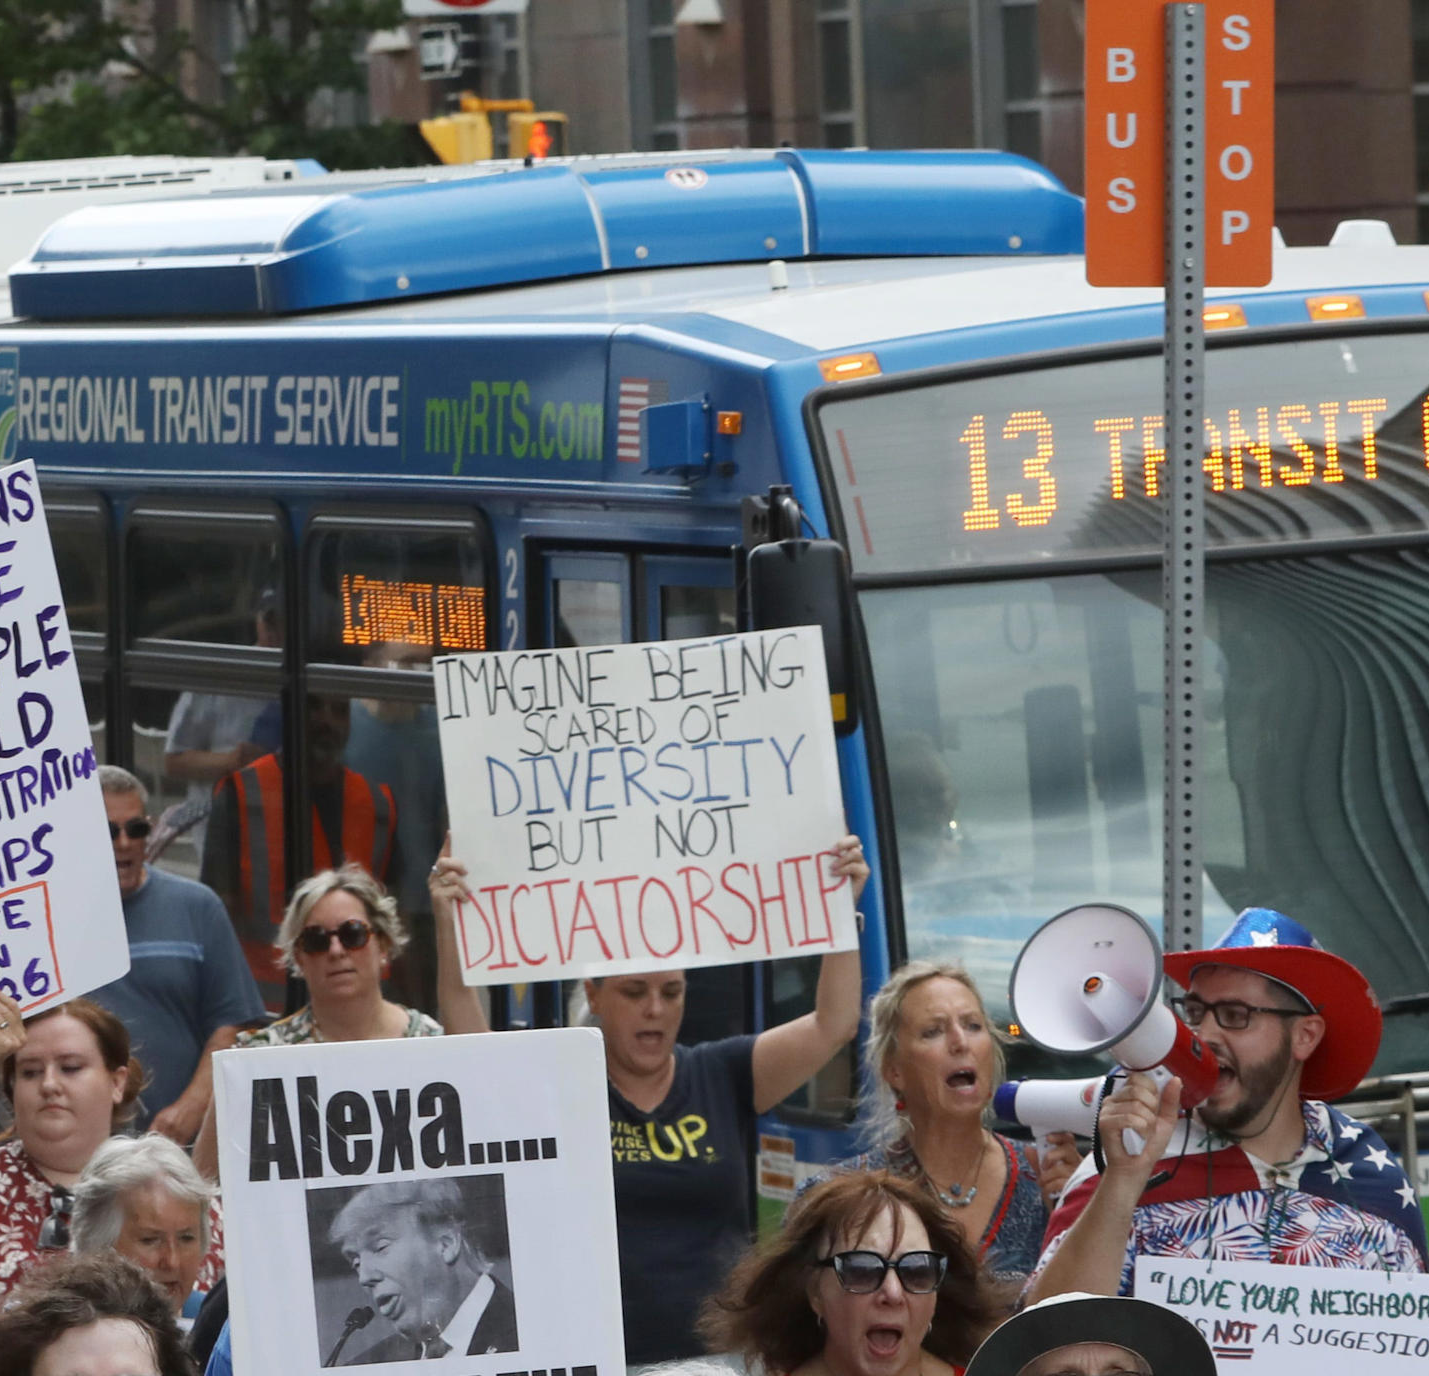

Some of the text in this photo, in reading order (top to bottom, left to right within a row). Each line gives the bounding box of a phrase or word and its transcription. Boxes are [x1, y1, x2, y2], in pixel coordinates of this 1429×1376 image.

[1105, 47, 1138, 215] BUS
[1219, 14, 1254, 247] STOP
[18, 375, 604, 475] REGIONAL TRANSIT SERVICE myRTS.com
[956, 409, 1059, 533] 13
[1093, 398, 1388, 500] TRANSIT
[437, 633, 804, 721] IMAGINE BEING
[519, 700, 740, 756] SCARED OF
[486, 734, 805, 817] DIVERSITY
[526, 803, 749, 872] BUT NOT
[455, 851, 849, 970] DICTATORSHIP
[1212, 1318, 1258, 1345] NOT
[1262, 1324, 1280, 1345] A
[1241, 1281, 1300, 1318] YOUR
